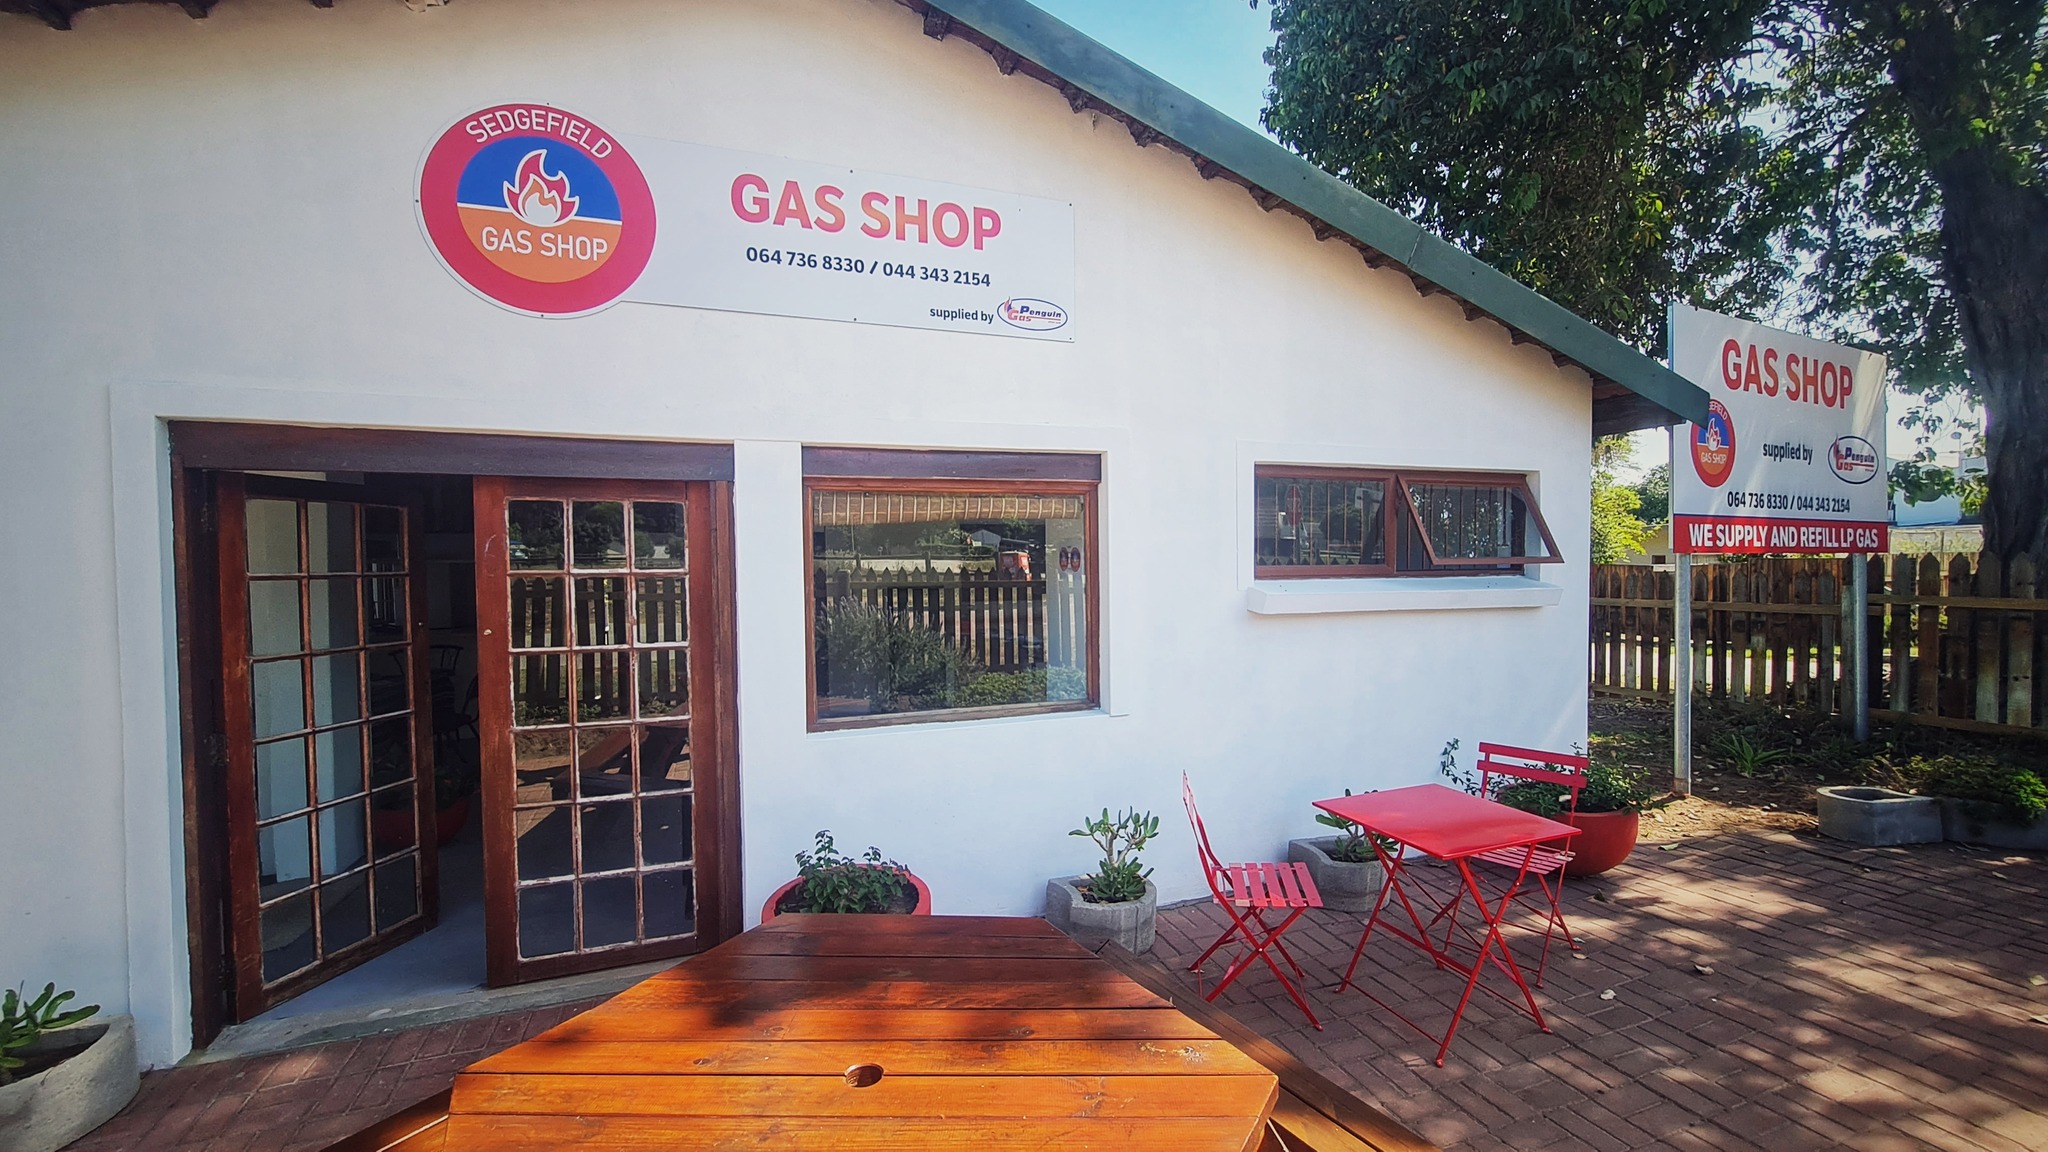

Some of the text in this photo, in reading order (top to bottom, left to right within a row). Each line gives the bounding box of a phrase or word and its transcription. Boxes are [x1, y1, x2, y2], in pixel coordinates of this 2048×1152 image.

[465, 108, 612, 158] SEDGEFIELD
[730, 173, 1001, 251] GAS SHOP
[481, 226, 608, 261] GAS SHOP
[746, 246, 991, 288] 064 736 8330 / 044 343 2154
[929, 308, 995, 325] supplied by
[1007, 309, 1032, 322] Gas
[1020, 305, 1062, 318] Penguin
[1722, 339, 1853, 409] GAS SHOP
[1700, 452, 1727, 464] GAS SHOP
[1763, 442, 1814, 465] supplied by
[1836, 453, 1854, 471] Gas
[1845, 447, 1875, 463] Penguin
[1727, 491, 1850, 513] 064 736 8330 / 044 343 2154
[1689, 523, 1879, 549] WE SUPPLY AND REFILL LP GAS
